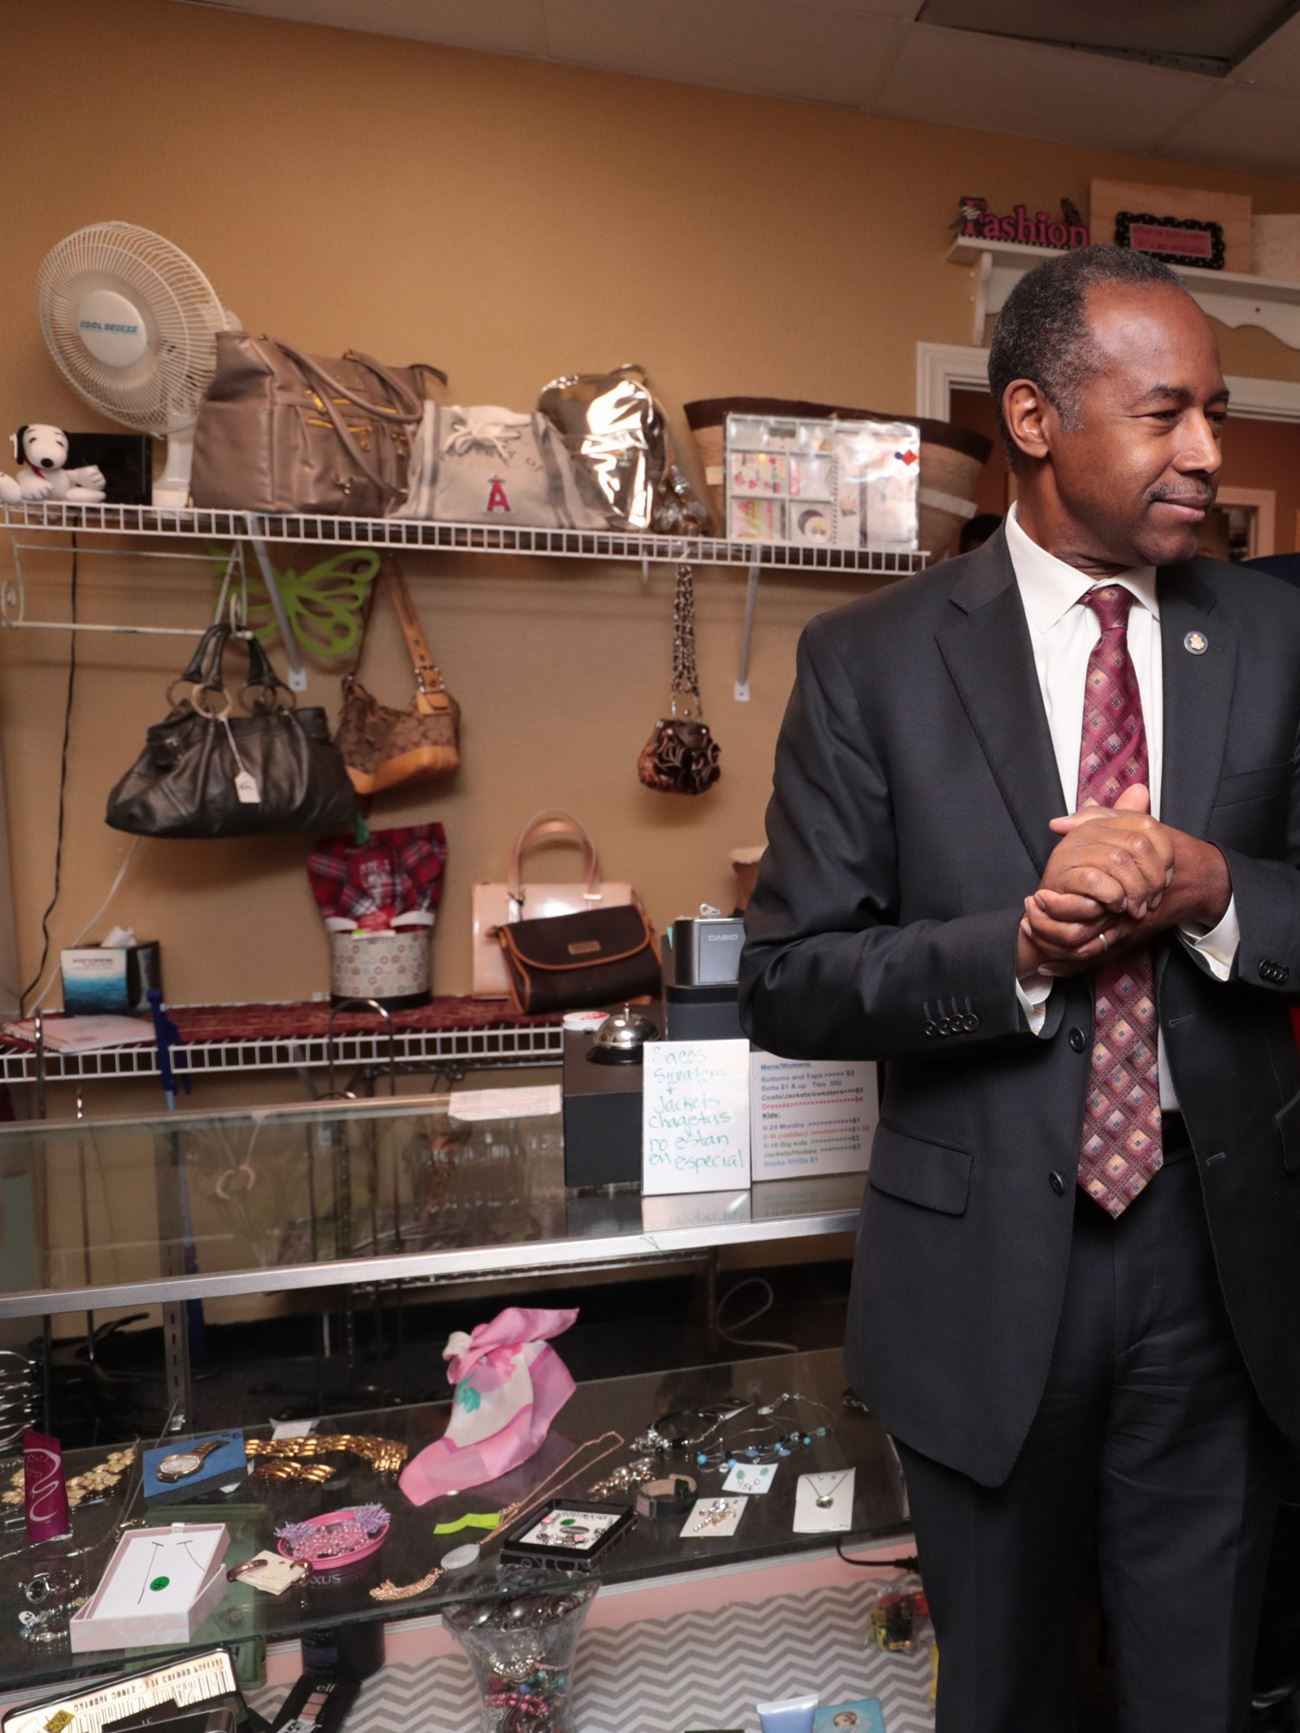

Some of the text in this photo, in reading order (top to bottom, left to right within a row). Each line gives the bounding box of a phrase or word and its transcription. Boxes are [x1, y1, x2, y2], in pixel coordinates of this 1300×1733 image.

[959, 196, 1089, 248] Fashion
[80, 320, 103, 331] COOL
[486, 474, 511, 513] A
[708, 934, 739, 942] CASIO
[653, 1092, 720, 1114] Jackets
[649, 1130, 729, 1152] no estan
[674, 1149, 745, 1175] especial
